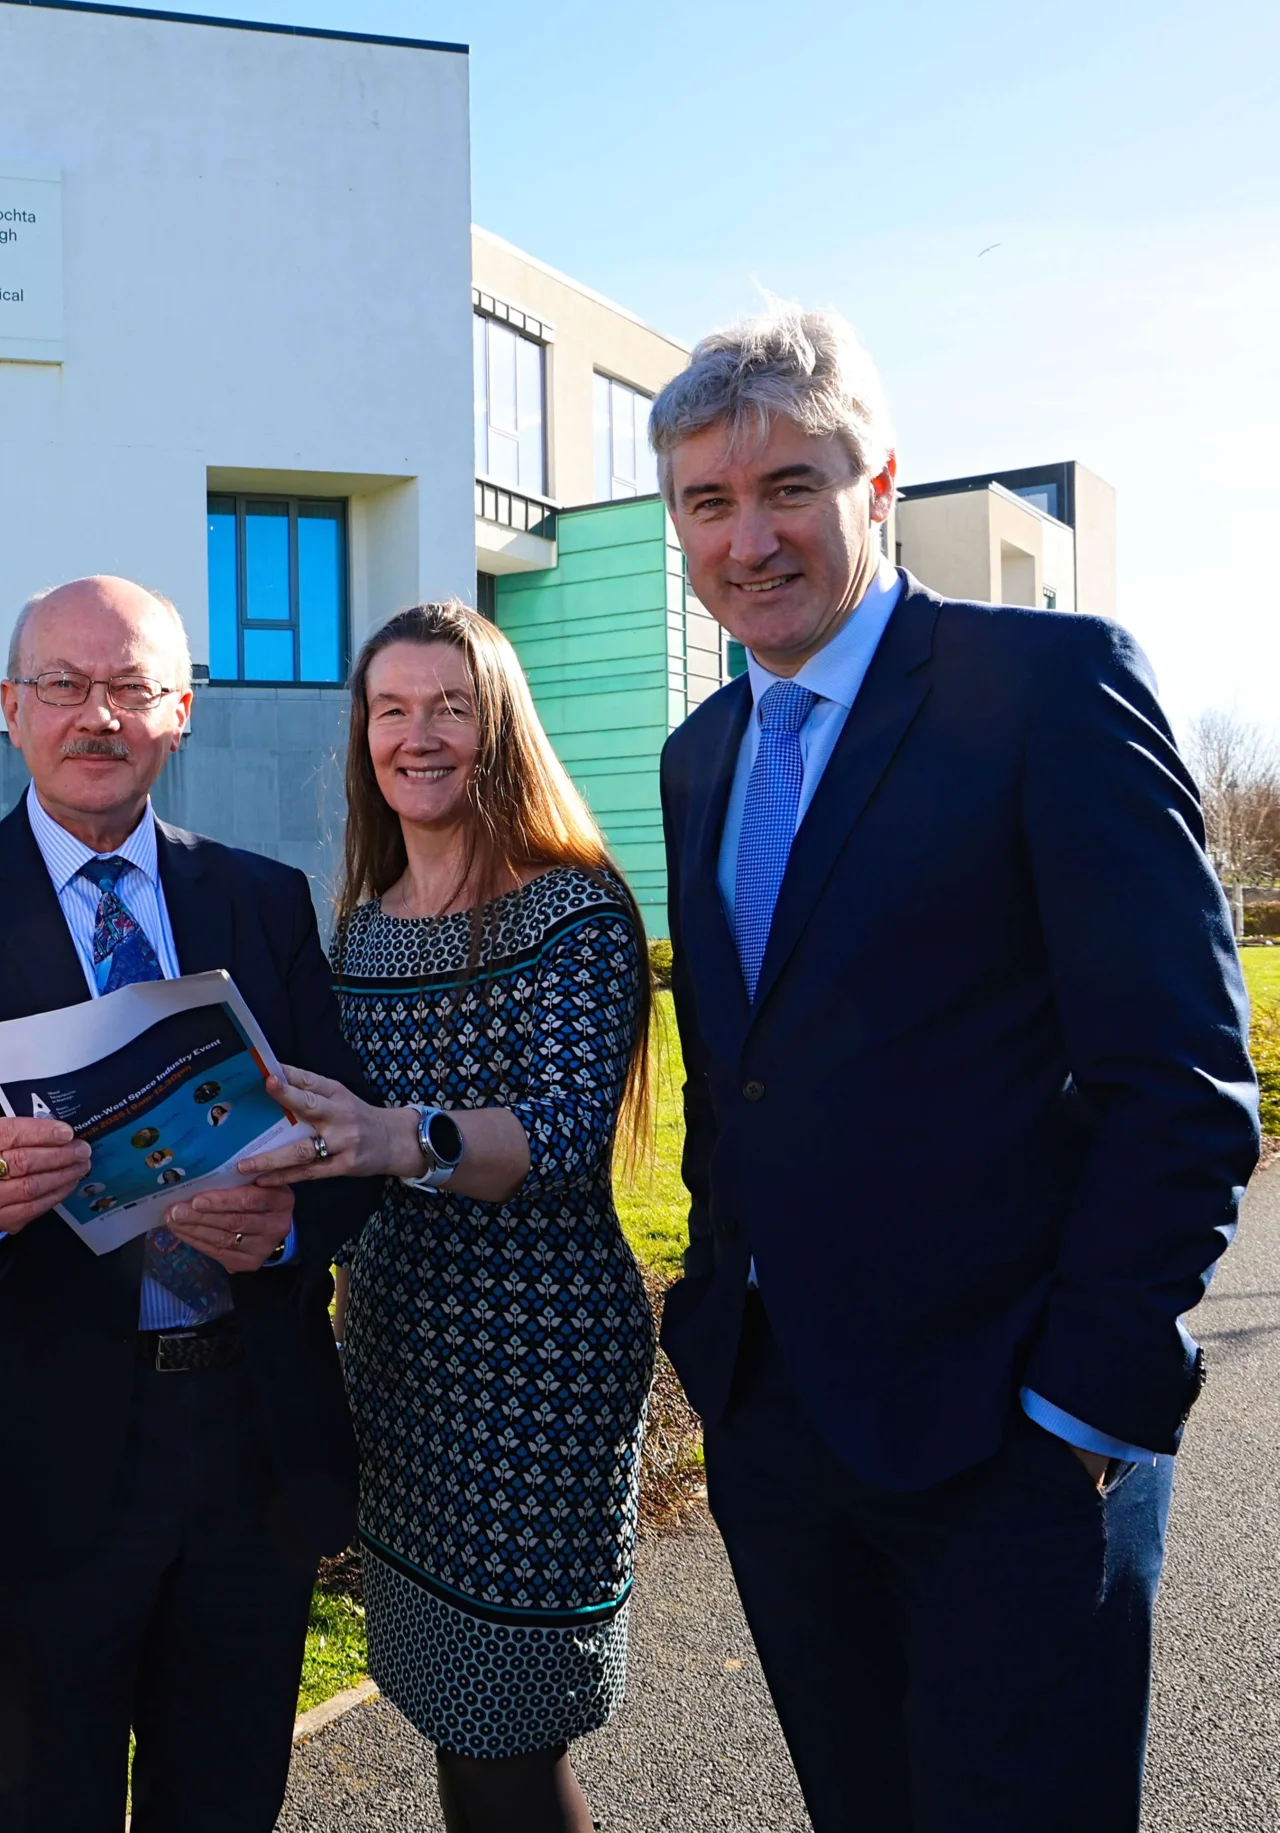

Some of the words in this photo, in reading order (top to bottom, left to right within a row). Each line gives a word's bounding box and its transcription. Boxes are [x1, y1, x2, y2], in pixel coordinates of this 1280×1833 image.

[74, 1098, 128, 1132] North-West
[127, 1080, 157, 1101] Space
[156, 1053, 192, 1082] Industry
[192, 1038, 221, 1056] Event
